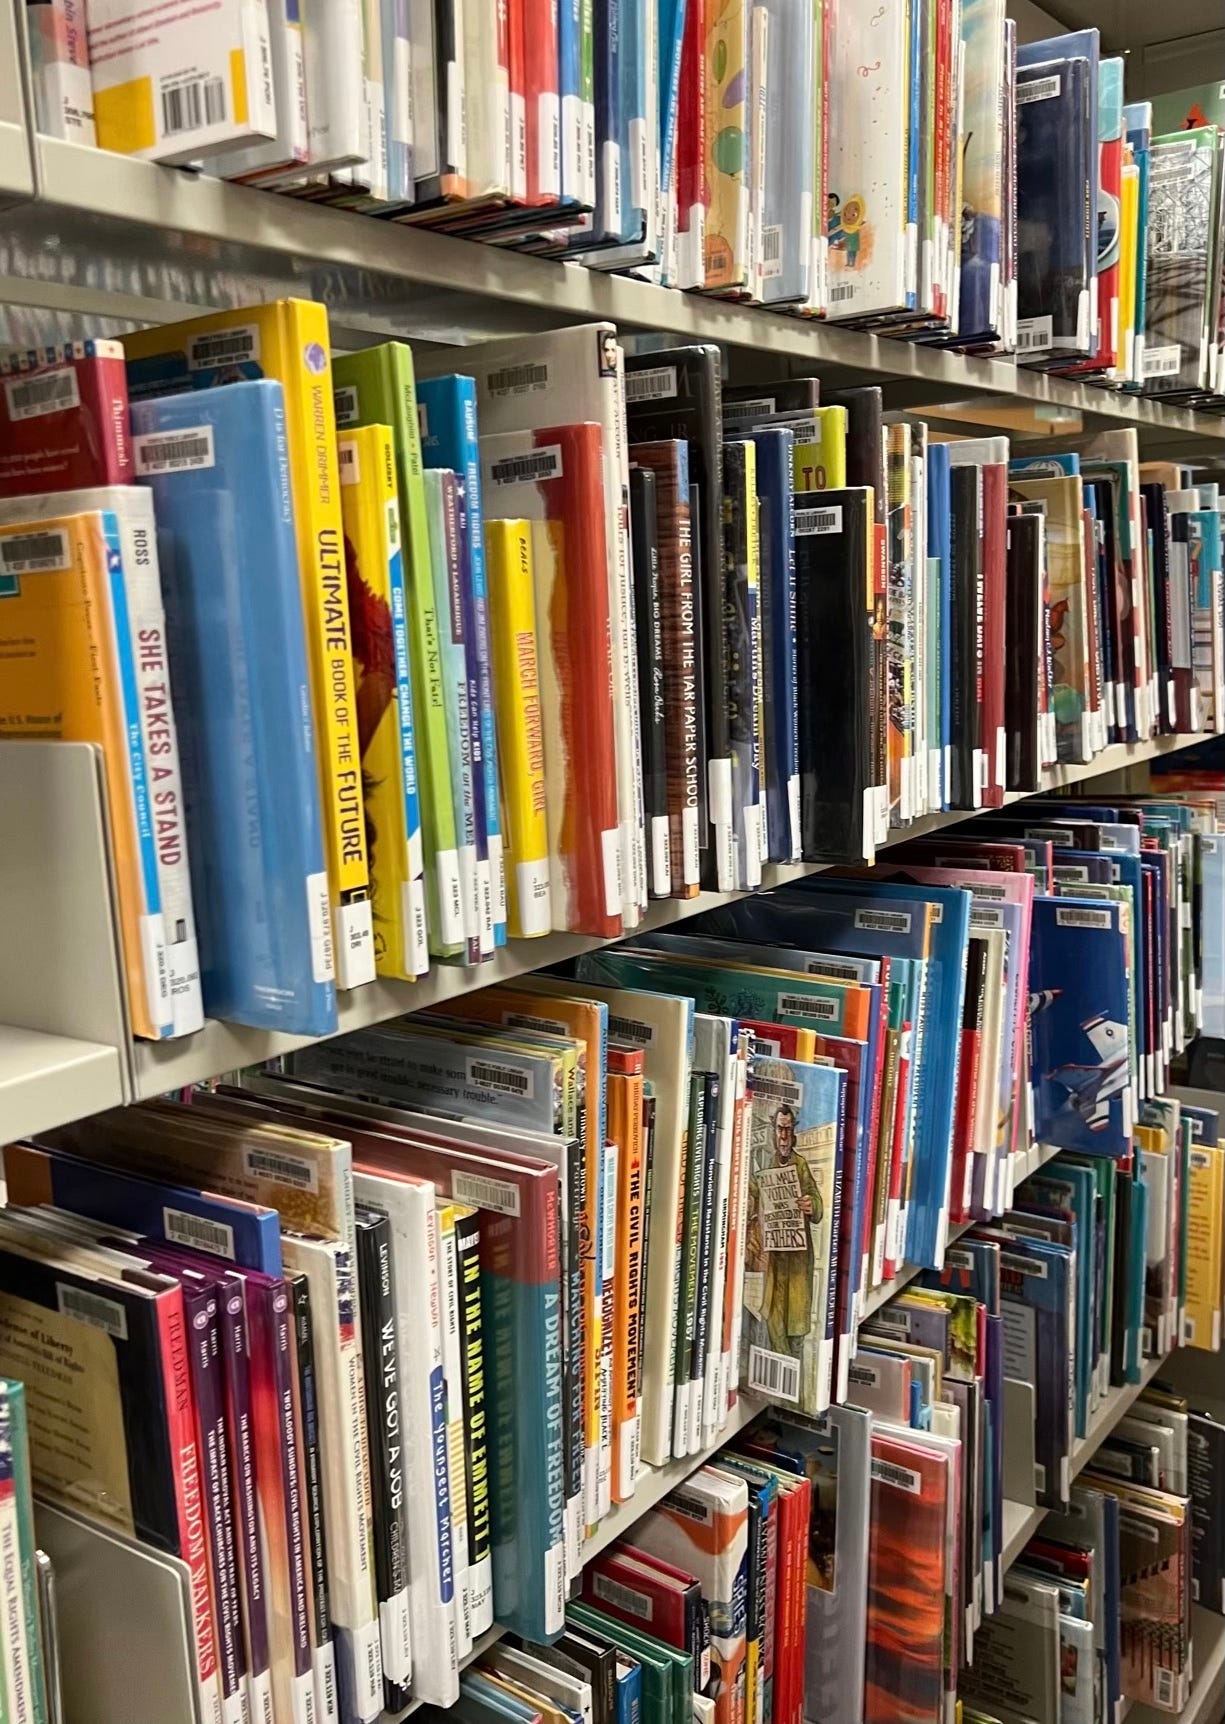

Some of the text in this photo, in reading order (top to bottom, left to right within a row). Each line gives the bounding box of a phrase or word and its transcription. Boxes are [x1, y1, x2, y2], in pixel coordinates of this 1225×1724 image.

[310, 385, 331, 504] WARREN DRIMMER
[463, 400, 476, 442] BAUSUM
[410, 453, 420, 476] Patel
[801, 465, 826, 492] TO
[446, 486, 458, 561] WEATHERFORD
[468, 462, 482, 549] FREEDOM RIDERS
[133, 529, 150, 566] ROSS
[652, 602, 660, 619] BIG
[788, 549, 798, 632] Let It Shine
[617, 547, 633, 707] for Wells
[653, 621, 662, 661] DREAMS
[427, 650, 443, 708] Not Fair!
[678, 519, 698, 808] THE GIRL FROM THE TAR PAPER SCHOO
[317, 529, 363, 865] ULTIMATE BOOK OF THE FUTURE
[392, 587, 416, 795] COME CHANGE THE WORLD
[457, 681, 473, 807] FREEDOM on the
[470, 680, 482, 762] Kids Can Help KIDS
[515, 631, 546, 818] MARCH FORWARD, GIRL
[139, 629, 182, 866] SHE TAKES A STAND
[751, 741, 761, 770] Day
[129, 722, 151, 838] The City Council
[566, 1067, 576, 1108] Wallace
[692, 1091, 705, 1197] EXPLORING CIVIL RIGHTS
[735, 1108, 743, 1132] CIVIL
[733, 1139, 742, 1172] RIGHTS
[706, 1158, 715, 1206] Nonviolent
[426, 1209, 436, 1261] Levinson
[703, 1208, 712, 1255] Resistance
[719, 1197, 728, 1249] BIRMINGHAM
[765, 1228, 806, 1248] FATHERS
[831, 1219, 840, 1253] Started
[379, 1243, 391, 1296] LEVINSON
[447, 1279, 454, 1289] OF
[627, 1170, 640, 1400] THE CIVIL RIGHTS MOVEMENT
[685, 1209, 699, 1341] THE 1957
[703, 1257, 710, 1267] in
[447, 1290, 455, 1308] CIVIL
[448, 1310, 456, 1335] RIGHTS
[600, 1278, 615, 1357] RECOGNIZE!
[699, 1308, 707, 1336] Rights
[167, 1312, 188, 1412] FREEDMAN
[200, 1340, 210, 1368] Harris
[209, 1328, 219, 1356] Harris
[233, 1325, 243, 1353] Harris
[278, 1324, 288, 1351] Harris
[570, 1271, 581, 1422] MARCHING FOR
[347, 1356, 356, 1402] WOMEN
[463, 1255, 490, 1543] IN THE NAME OF EMMETT
[349, 1403, 357, 1415] IN
[350, 1419, 359, 1440] THE
[381, 1318, 402, 1510] WE'VE GOT A JOB
[544, 1293, 564, 1547] A DREAM OF FREEDOM
[600, 1414, 610, 1442] BLACK
[352, 1440, 361, 1469] CIVIL
[220, 1467, 231, 1507] REMOVAL
[239, 1413, 261, 1601] THE MARCH ON WASHINGTON AND ITS LEGACY
[355, 1471, 364, 1511] RIGHTS
[433, 1380, 452, 1585] The Youngest Marcher
[207, 1430, 234, 1655] THE IMPACT OF BLACK CHURCHES ON THE CIVIL RIGHTS
[283, 1390, 308, 1649] TWO BLOODY CIVIL RIGHTS IN AMERICA AND IRELAND
[357, 1513, 368, 1572] MOVEMENT
[178, 1441, 216, 1674] FREEDOM WALKERS
[2, 1525, 26, 1724] THE EQUAL RIGHTS AMENDMENT
